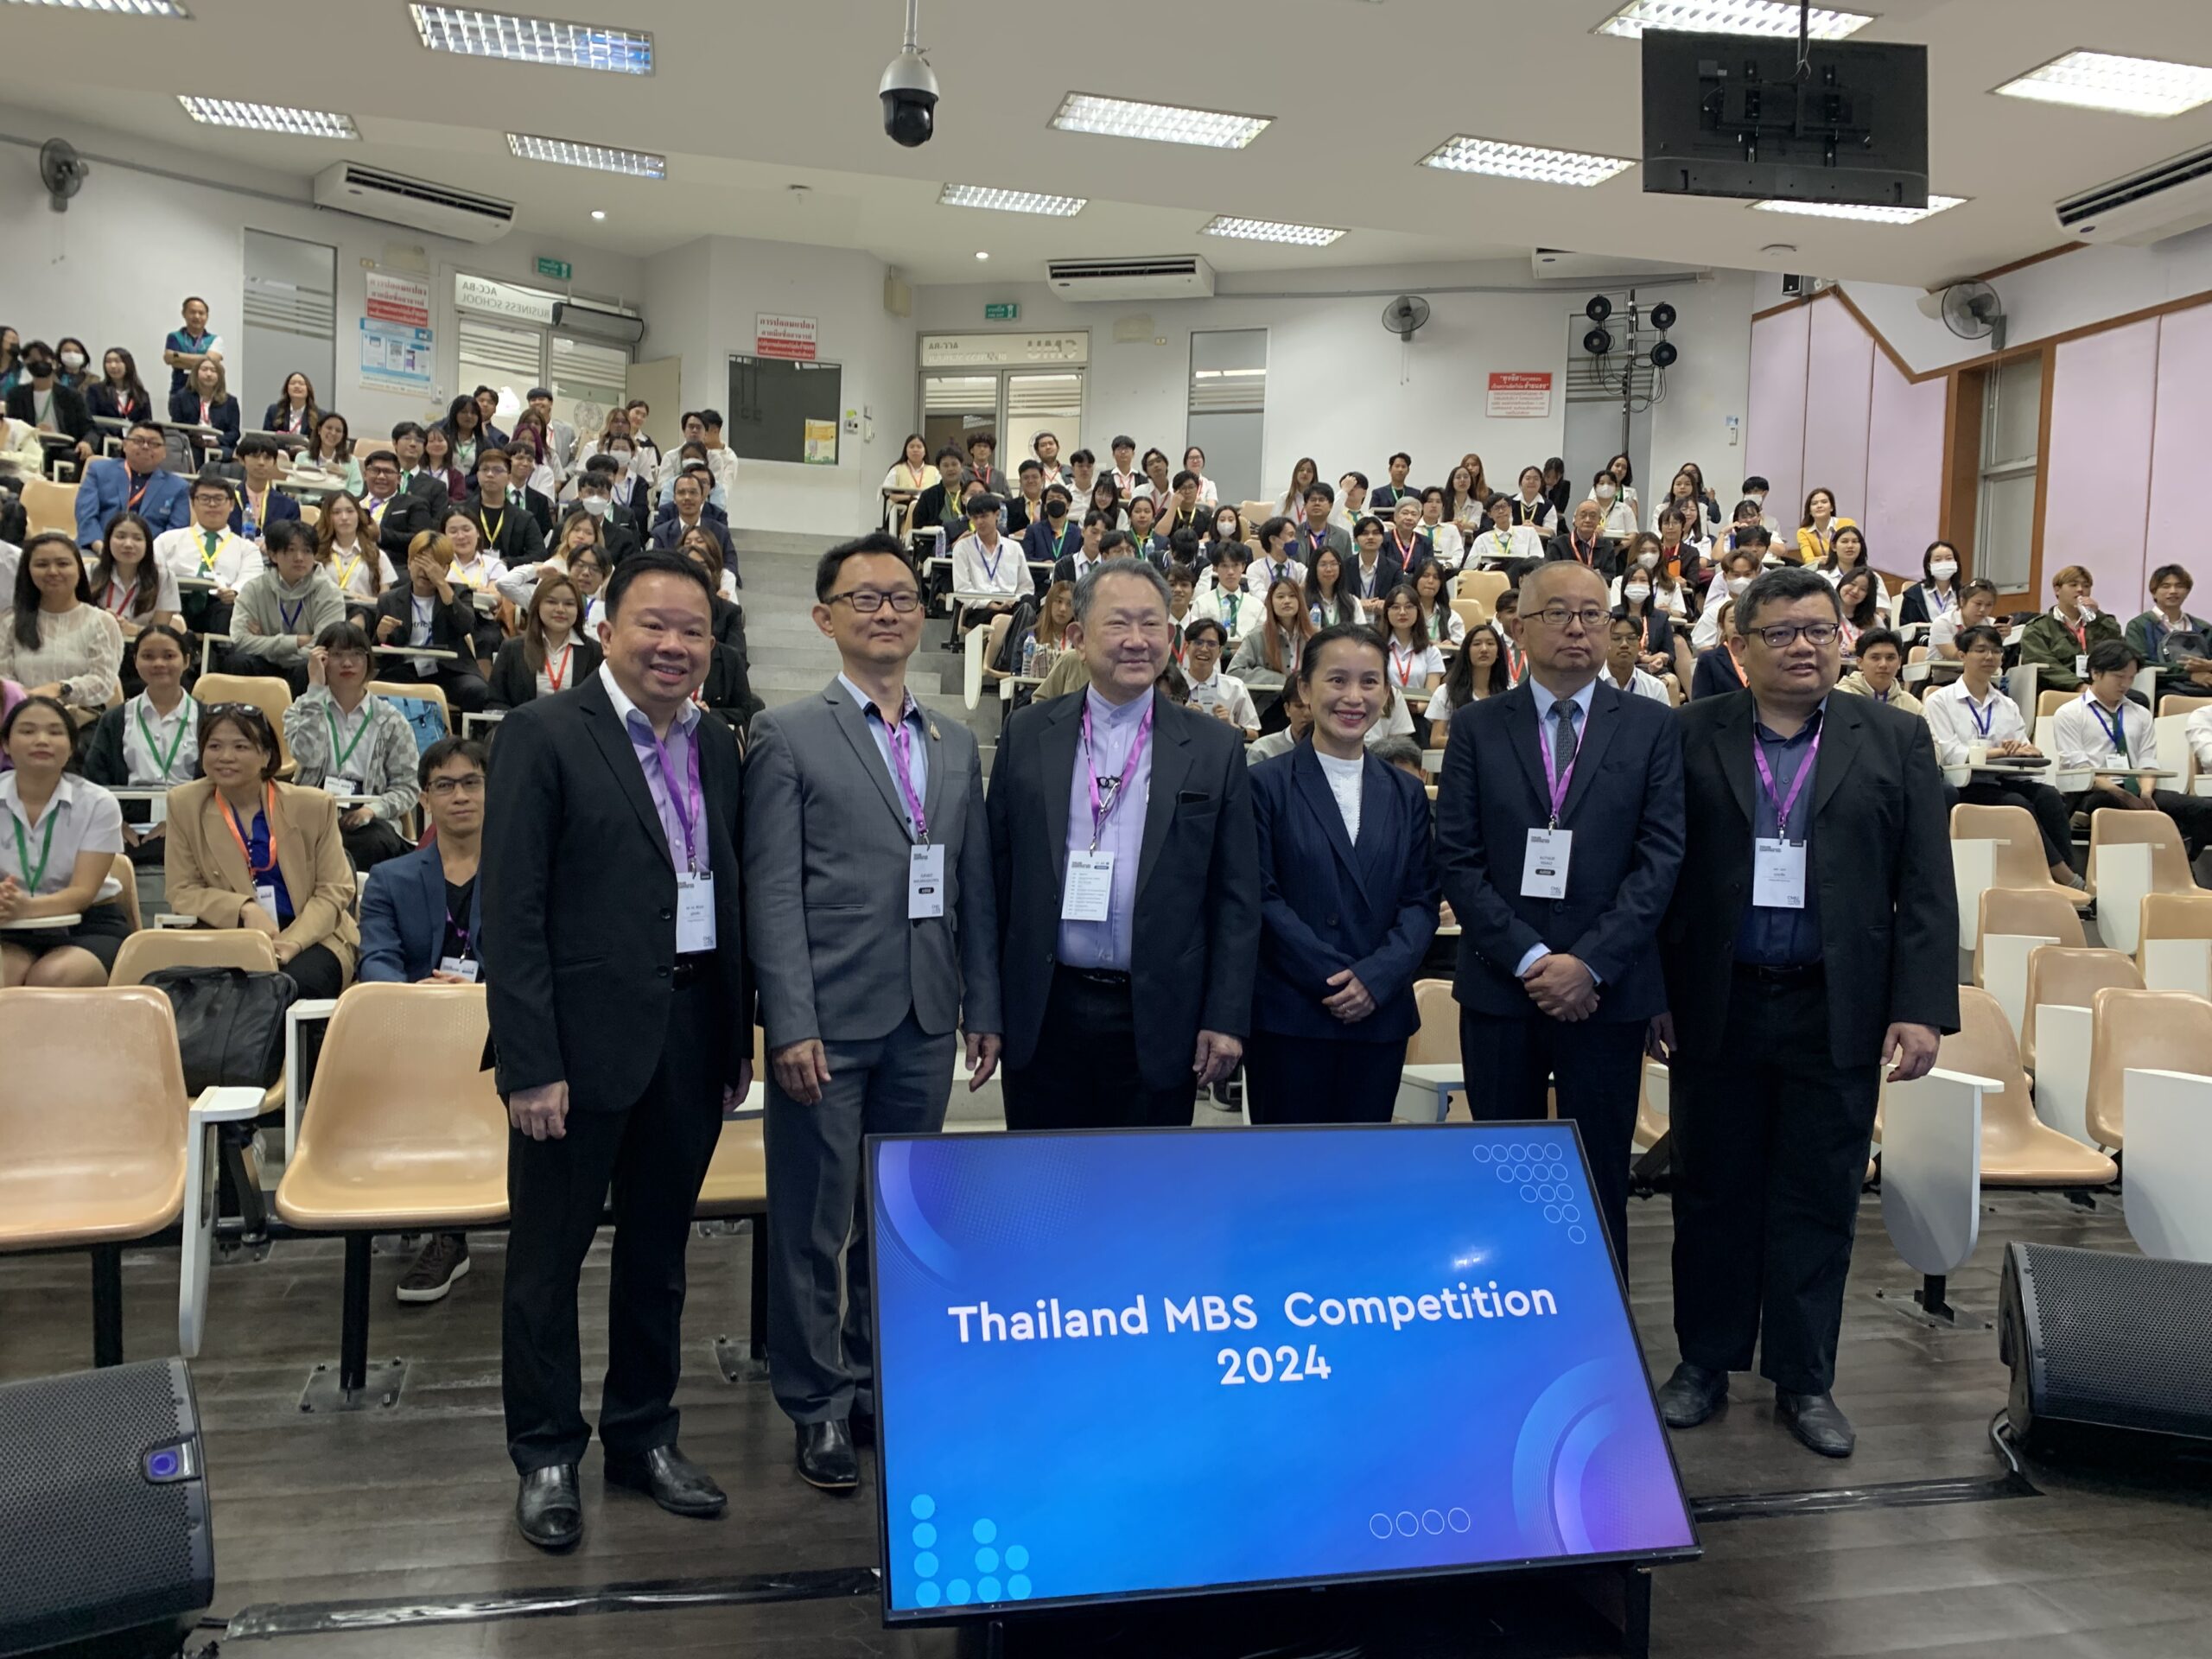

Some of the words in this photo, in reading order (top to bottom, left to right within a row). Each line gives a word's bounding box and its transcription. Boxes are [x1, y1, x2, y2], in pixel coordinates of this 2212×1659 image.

[948, 1294, 1148, 1343] Thailand
[1164, 1294, 1257, 1332] MBS
[1284, 1281, 1557, 1331] Competition
[1217, 1344, 1332, 1384] 2024
